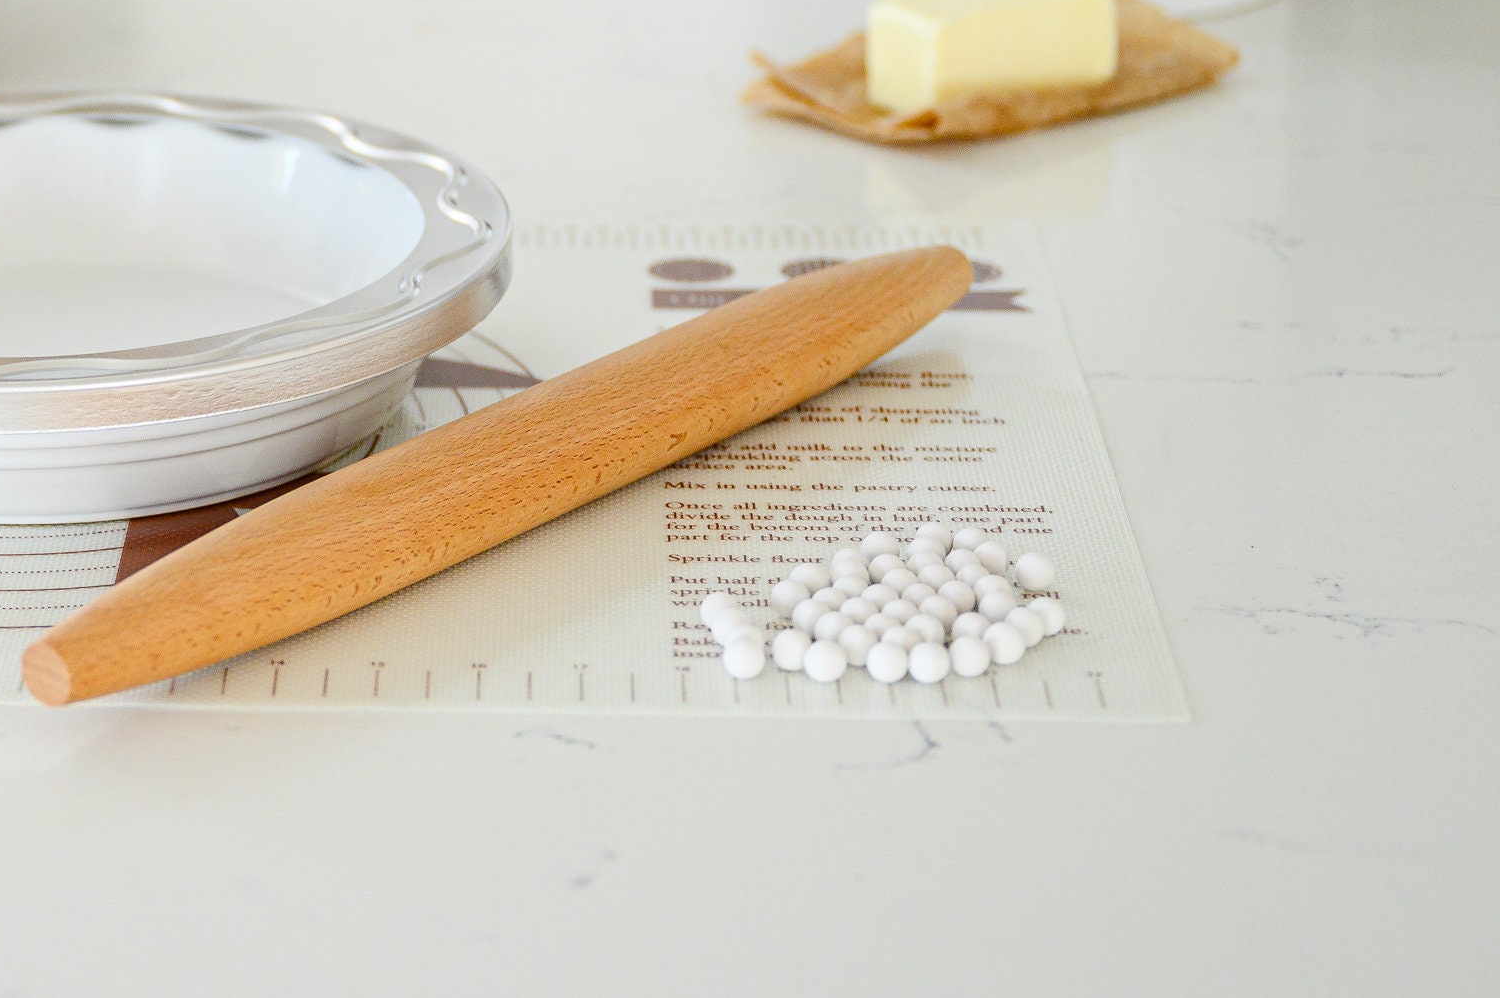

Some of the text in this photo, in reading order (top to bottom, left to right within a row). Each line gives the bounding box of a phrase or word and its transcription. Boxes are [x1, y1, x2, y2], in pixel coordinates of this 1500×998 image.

[740, 443, 777, 452] add
[787, 443, 832, 452] milk
[842, 444, 864, 452] to
[872, 443, 906, 452] the
[914, 445, 997, 453] mixture
[809, 454, 872, 462] across
[881, 453, 914, 462] the
[923, 454, 984, 463] entire
[664, 481, 997, 494] Mix in using the pastry cutter.
[665, 501, 724, 511] Once
[733, 502, 757, 511] all
[766, 502, 887, 513] ingredients
[937, 505, 1054, 514] combined,
[665, 511, 1046, 525] divide the dough in half, one part
[666, 522, 698, 531] for
[706, 522, 740, 531] the
[749, 523, 830, 533] bottom
[839, 523, 865, 532] of
[871, 524, 906, 533] the
[665, 533, 711, 543] part
[719, 533, 751, 542] for
[760, 534, 795, 543] the
[804, 535, 841, 544] top
[668, 554, 824, 565] Sprinkle flour
[670, 575, 708, 585] Put
[716, 576, 762, 585] half
